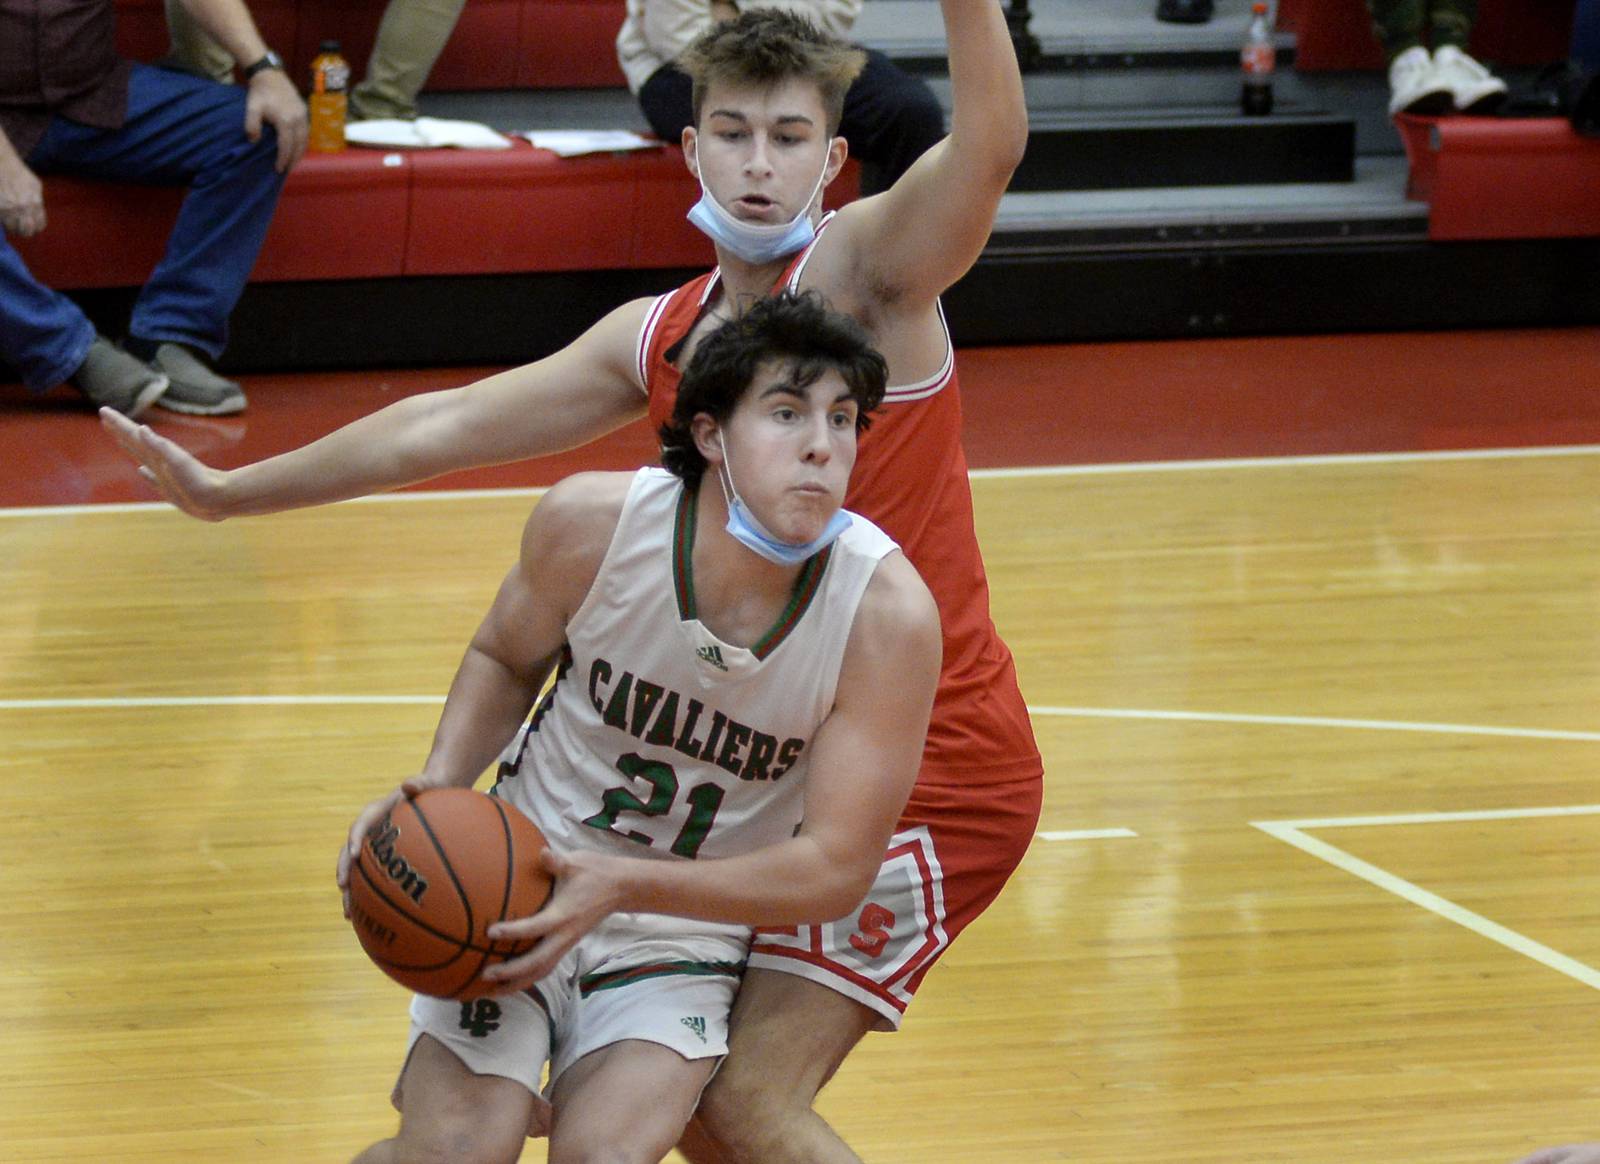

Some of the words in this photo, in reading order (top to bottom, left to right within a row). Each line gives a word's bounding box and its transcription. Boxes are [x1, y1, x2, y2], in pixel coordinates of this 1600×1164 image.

[589, 658, 805, 781] CAVALIERS
[582, 752, 725, 860] 21
[848, 902, 896, 959] S
